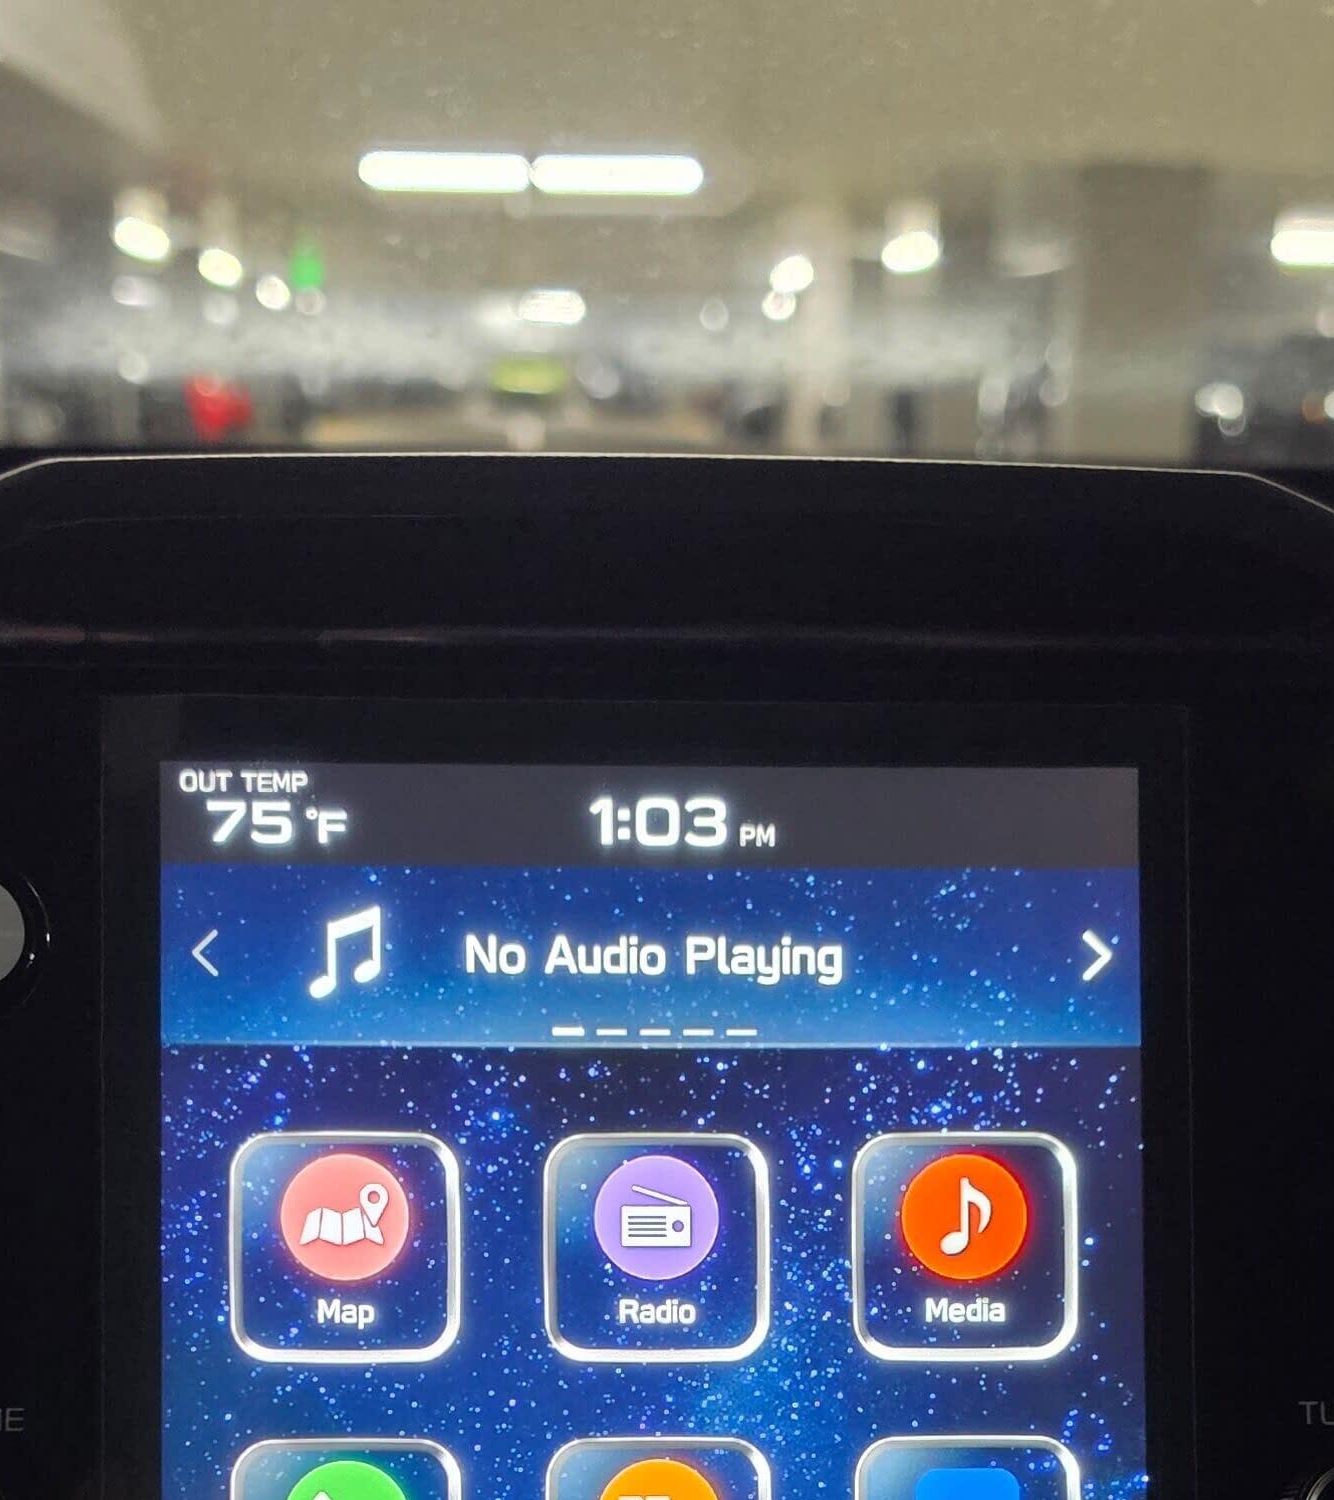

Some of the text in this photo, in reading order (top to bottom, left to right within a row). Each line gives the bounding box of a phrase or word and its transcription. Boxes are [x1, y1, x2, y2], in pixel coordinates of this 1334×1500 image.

[179, 769, 308, 793] OUT TEMP
[206, 799, 293, 845] 75
[588, 794, 776, 847] 1:03 PM
[466, 932, 843, 986] No Audio Playing
[316, 1298, 376, 1330] Map
[618, 1297, 697, 1325] Radio
[924, 1296, 1007, 1324] Media
